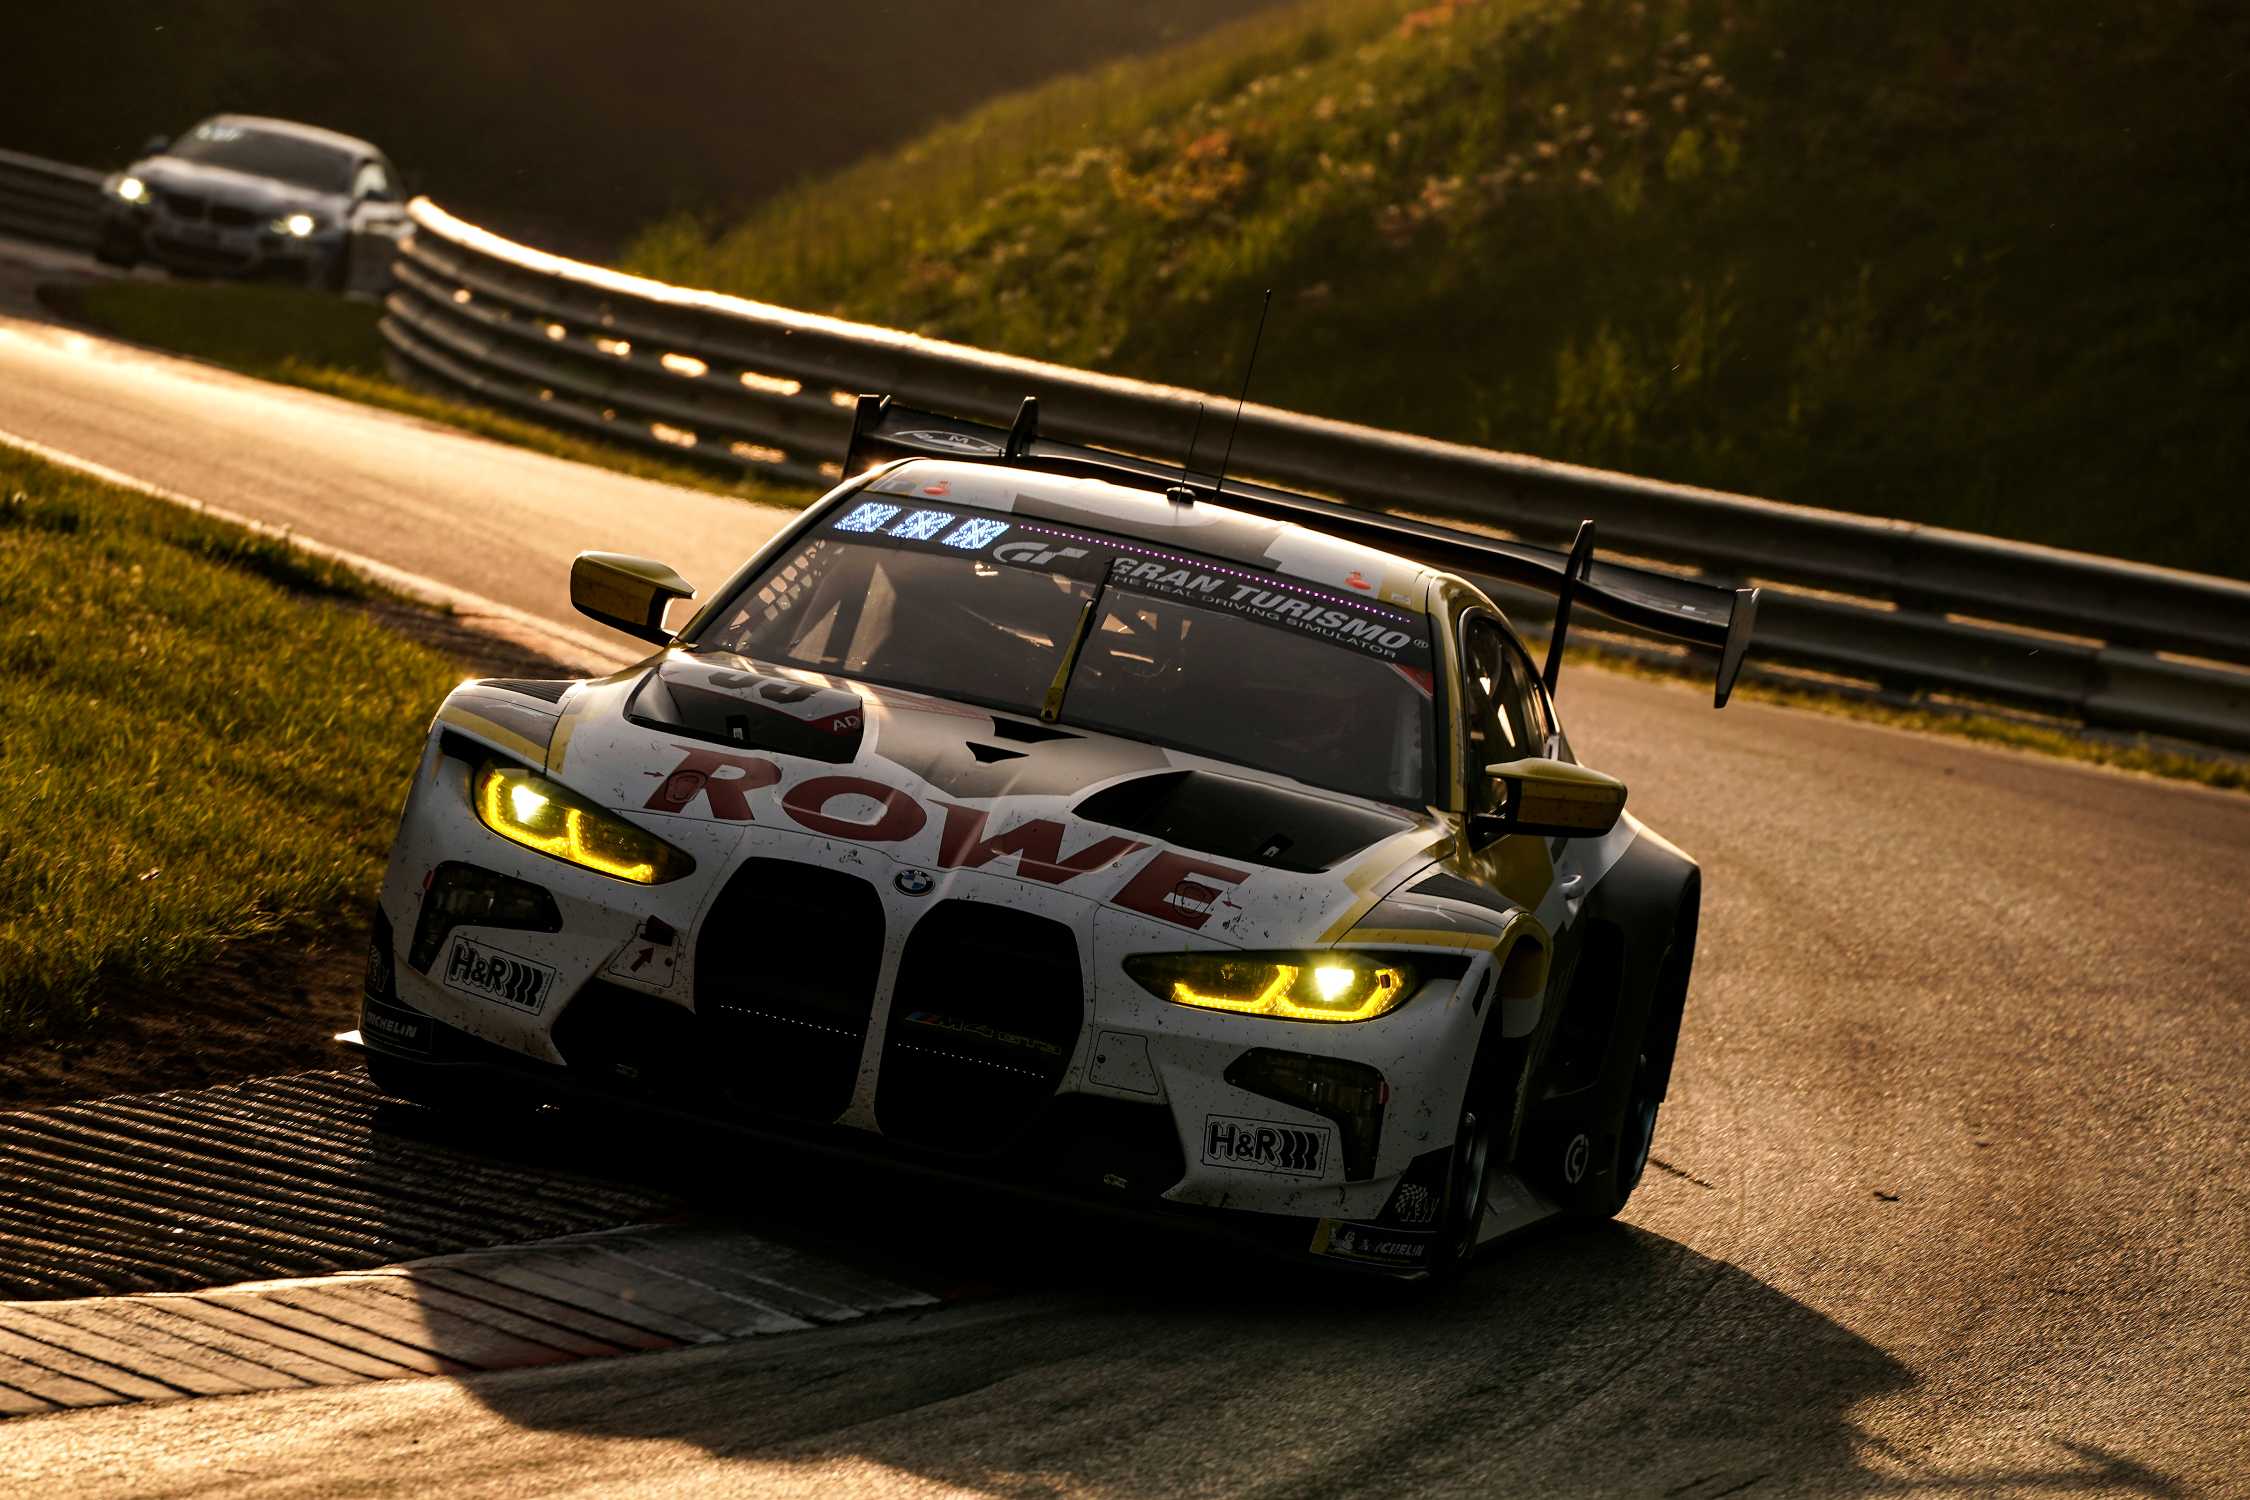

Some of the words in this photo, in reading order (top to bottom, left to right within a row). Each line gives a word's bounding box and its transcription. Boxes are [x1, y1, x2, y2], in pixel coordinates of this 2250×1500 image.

[1112, 557, 1215, 594] GRAN
[1146, 580, 1194, 600] REAL
[1202, 594, 1280, 622] DRIVING
[1285, 617, 1397, 659] SIMULATOR
[643, 744, 1253, 930] ROWE
